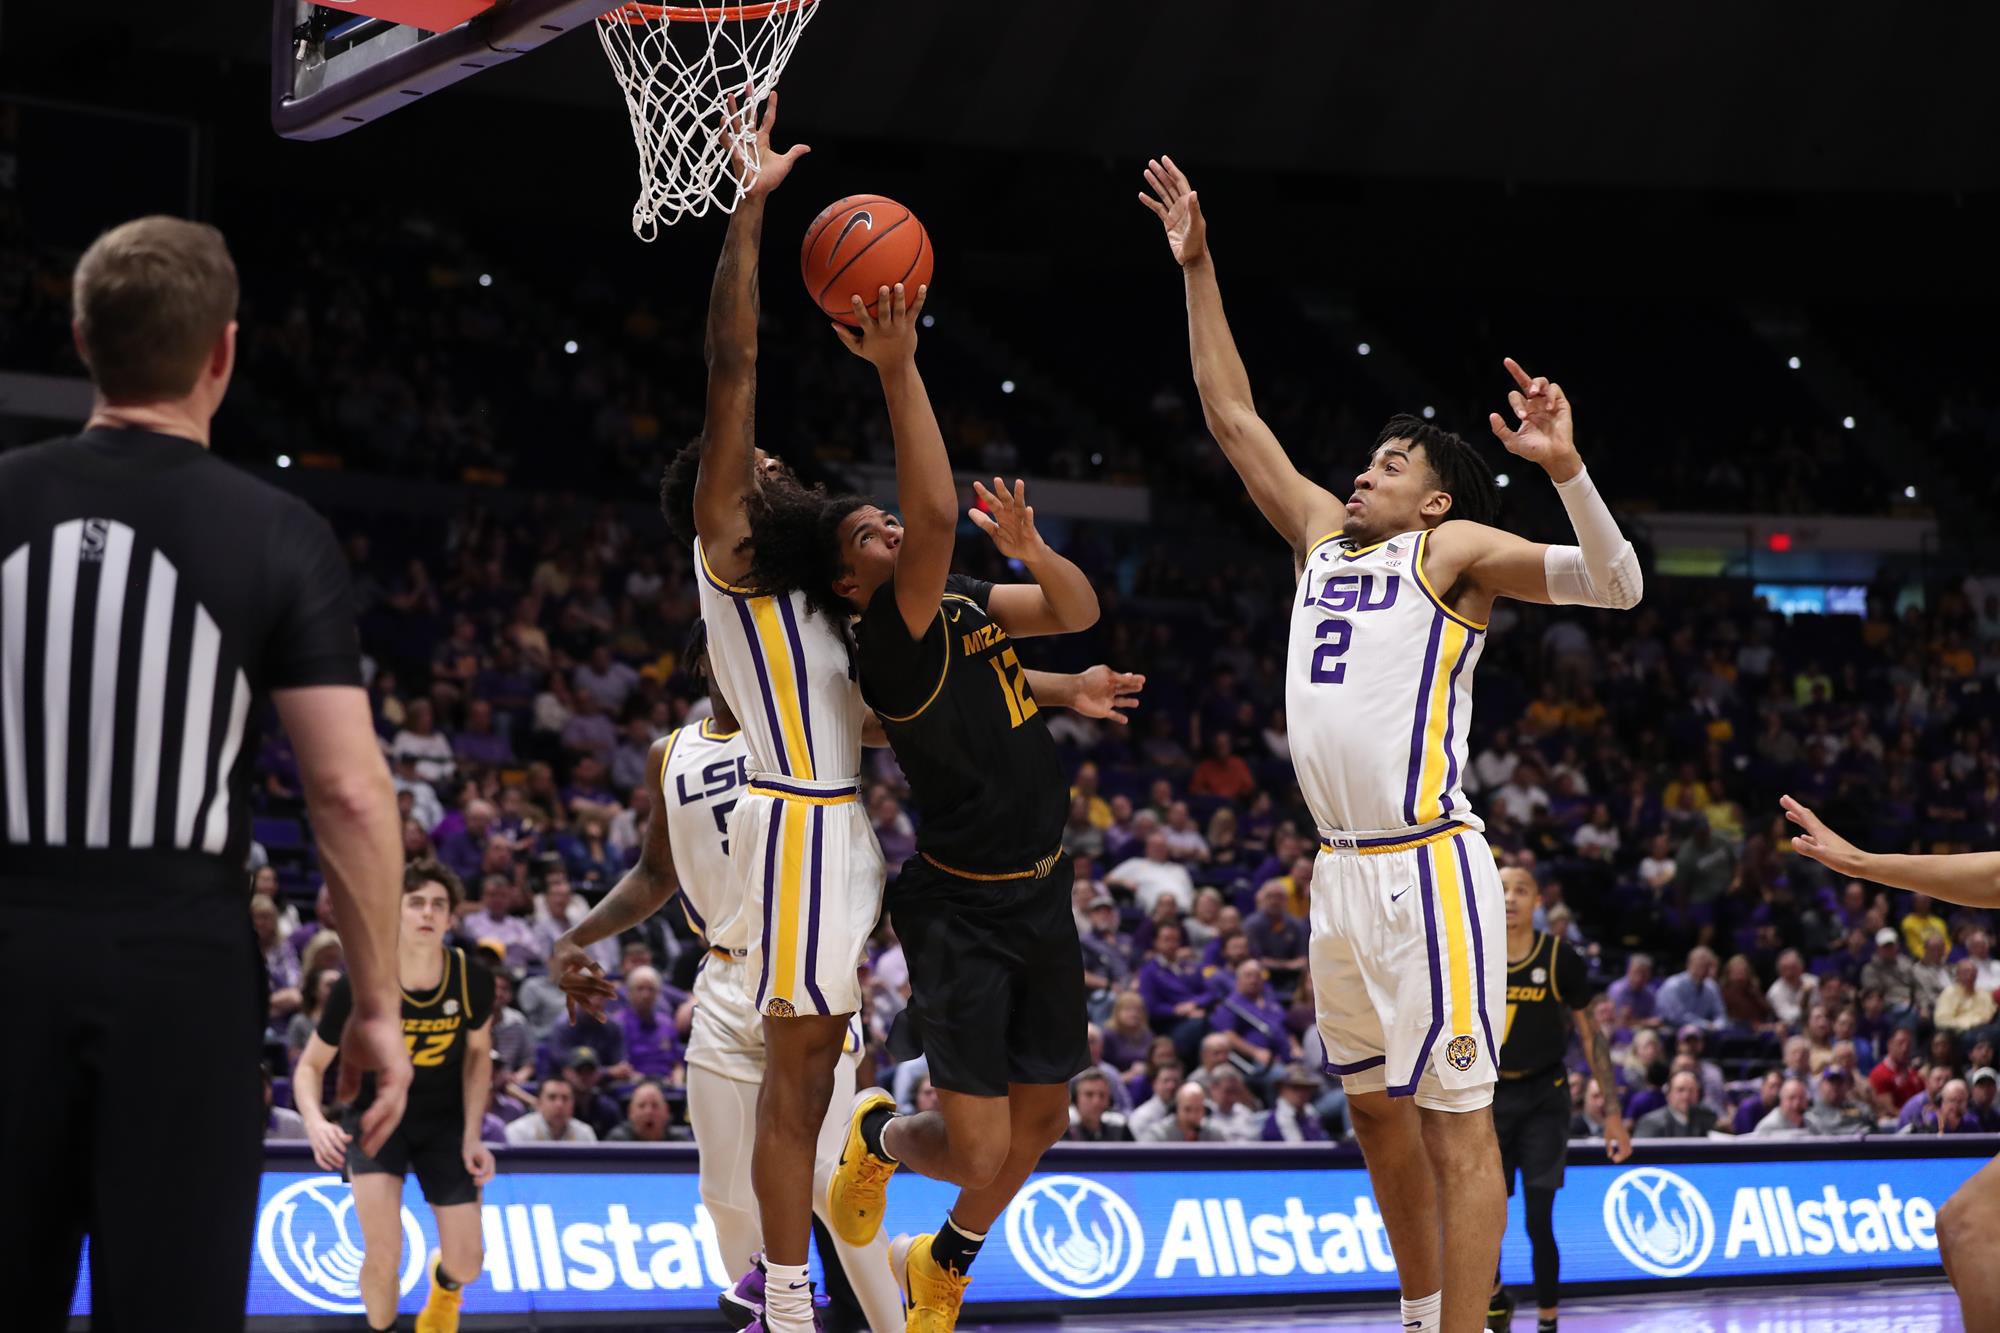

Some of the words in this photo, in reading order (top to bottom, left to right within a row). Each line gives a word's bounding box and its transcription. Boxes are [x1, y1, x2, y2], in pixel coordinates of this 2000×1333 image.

[1303, 569, 1400, 612] LSU
[962, 622, 1006, 656] MIZZ
[1311, 619, 1352, 684] 2
[988, 646, 1038, 728] 12
[1332, 839, 1355, 848] LSU
[480, 1203, 734, 1292] llstat
[1154, 1195, 1397, 1279] Allstat
[1724, 1183, 1940, 1259] Allstate
